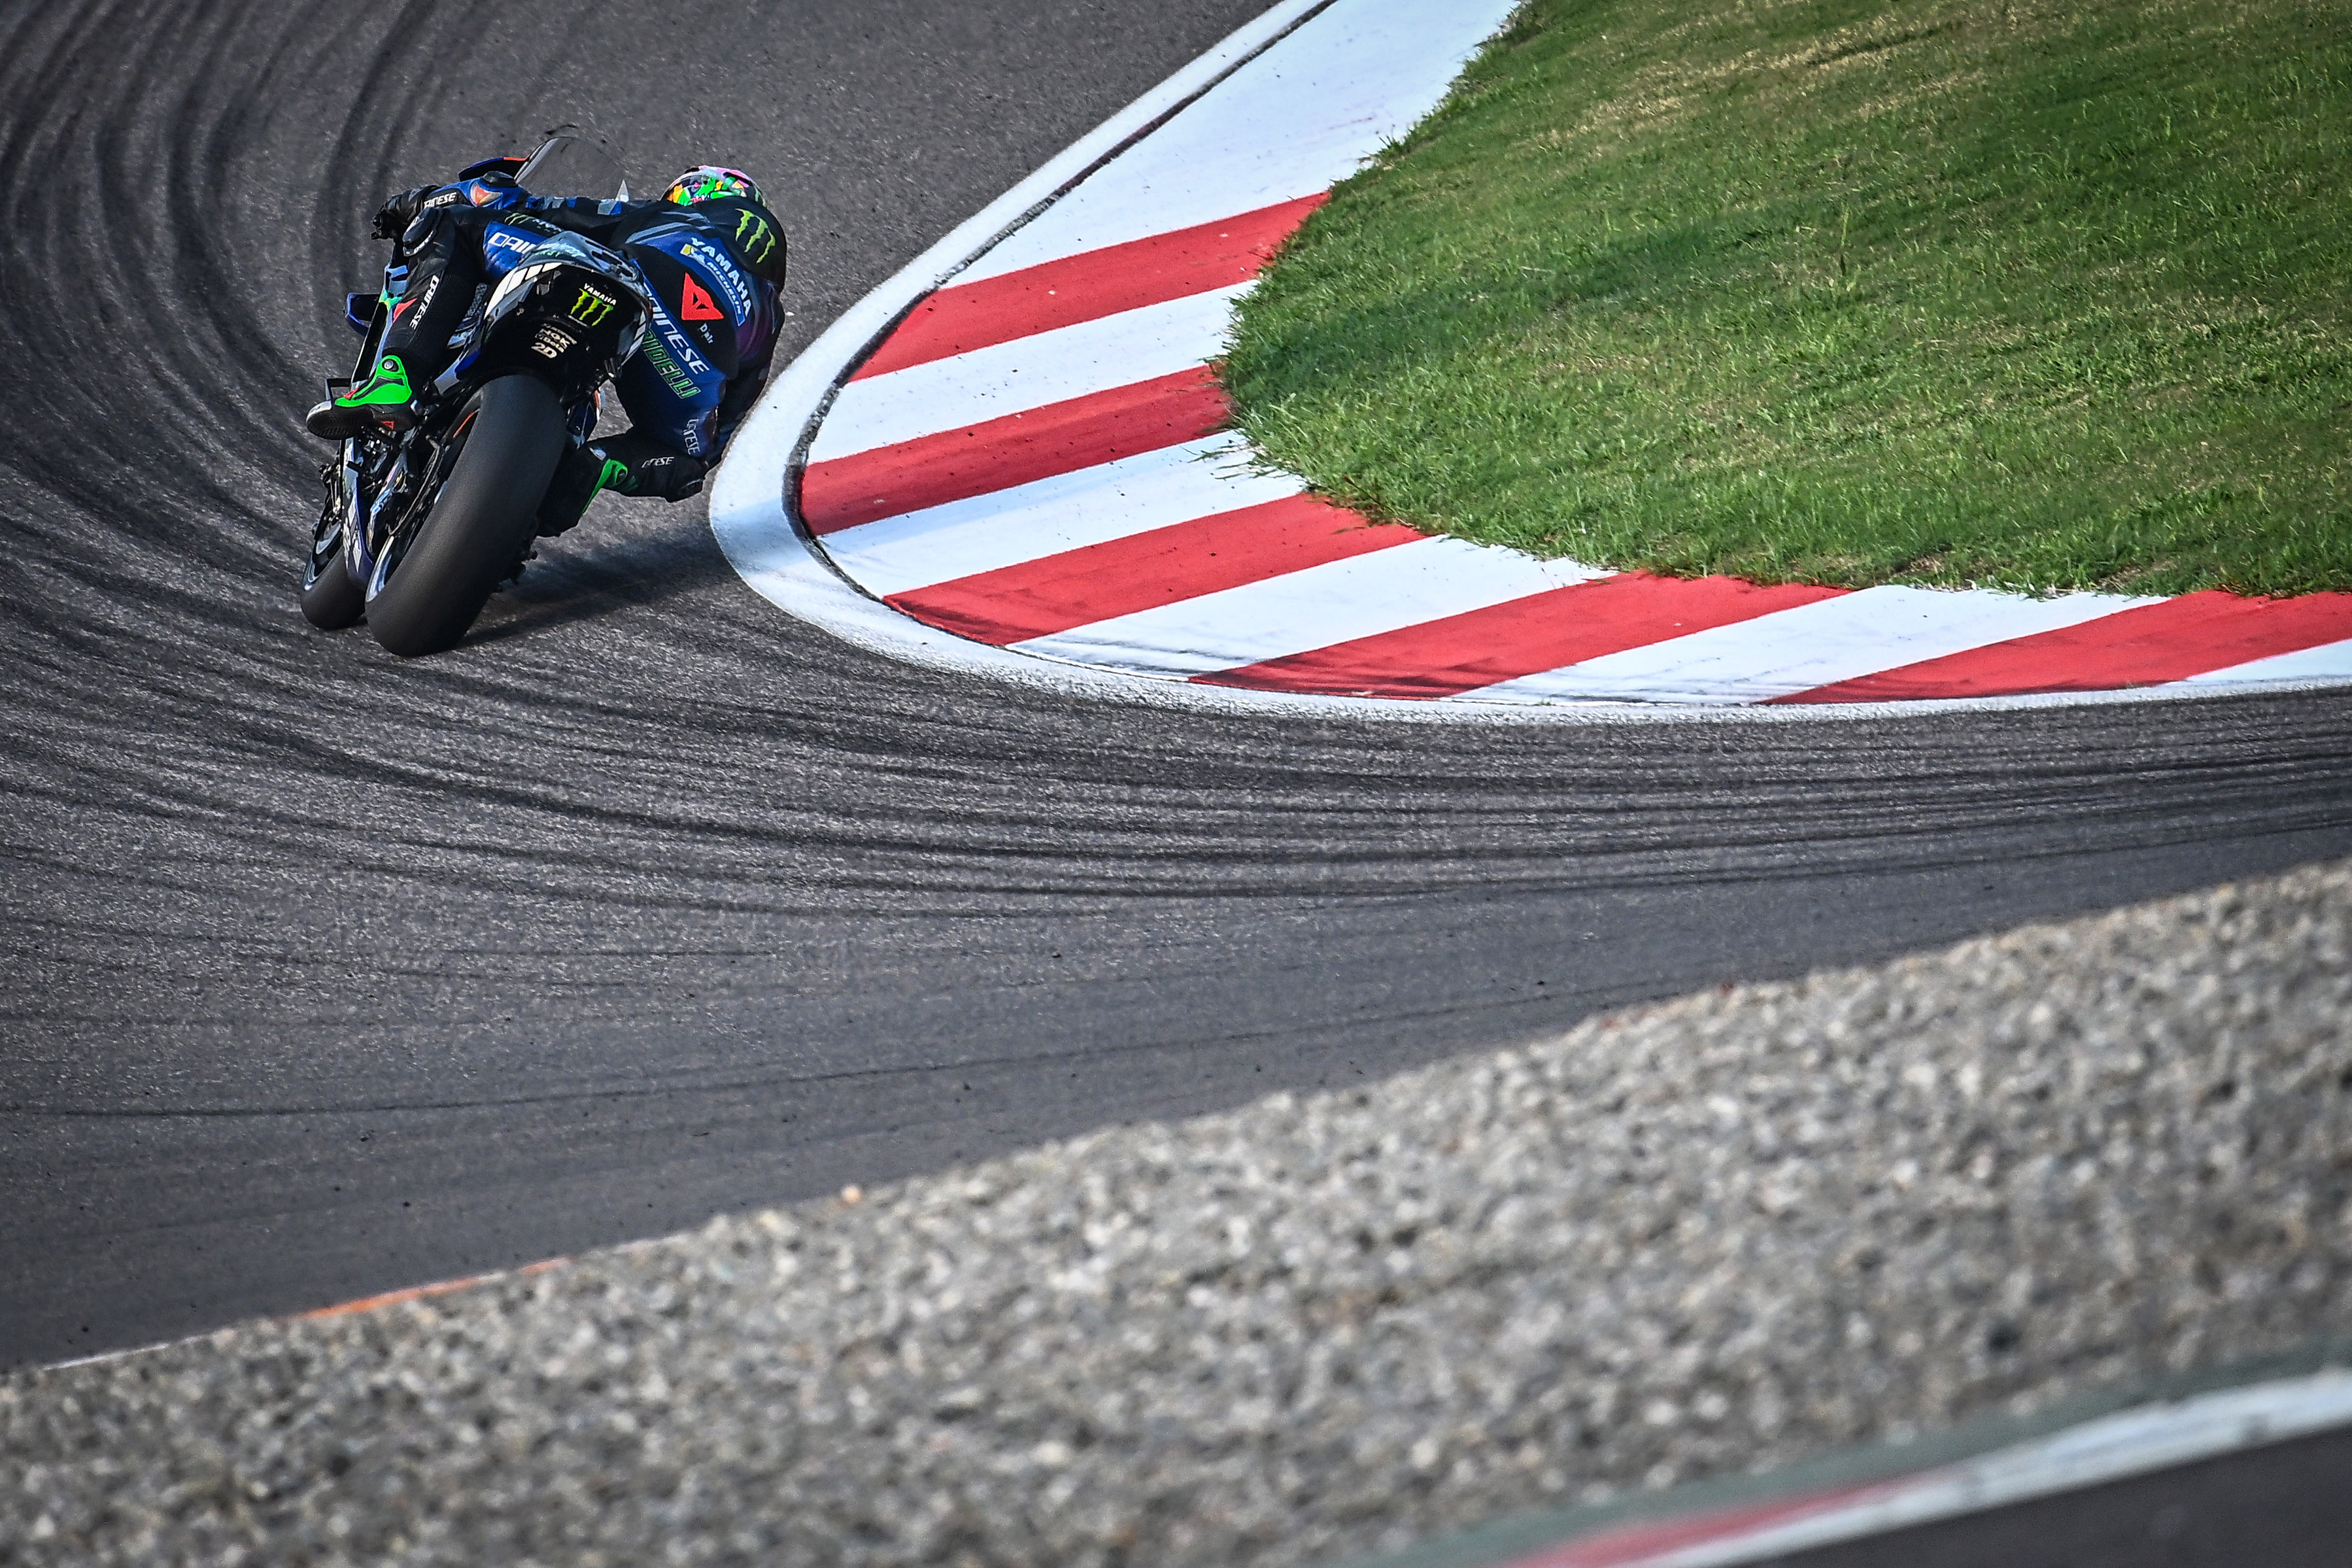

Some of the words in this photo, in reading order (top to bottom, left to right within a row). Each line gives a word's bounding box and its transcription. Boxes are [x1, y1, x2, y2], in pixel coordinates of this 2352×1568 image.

[409, 275, 439, 330] DAINESE
[583, 282, 617, 305] YAMAHA
[691, 237, 751, 317] YAMAHA
[707, 262, 741, 314] MICHELIN
